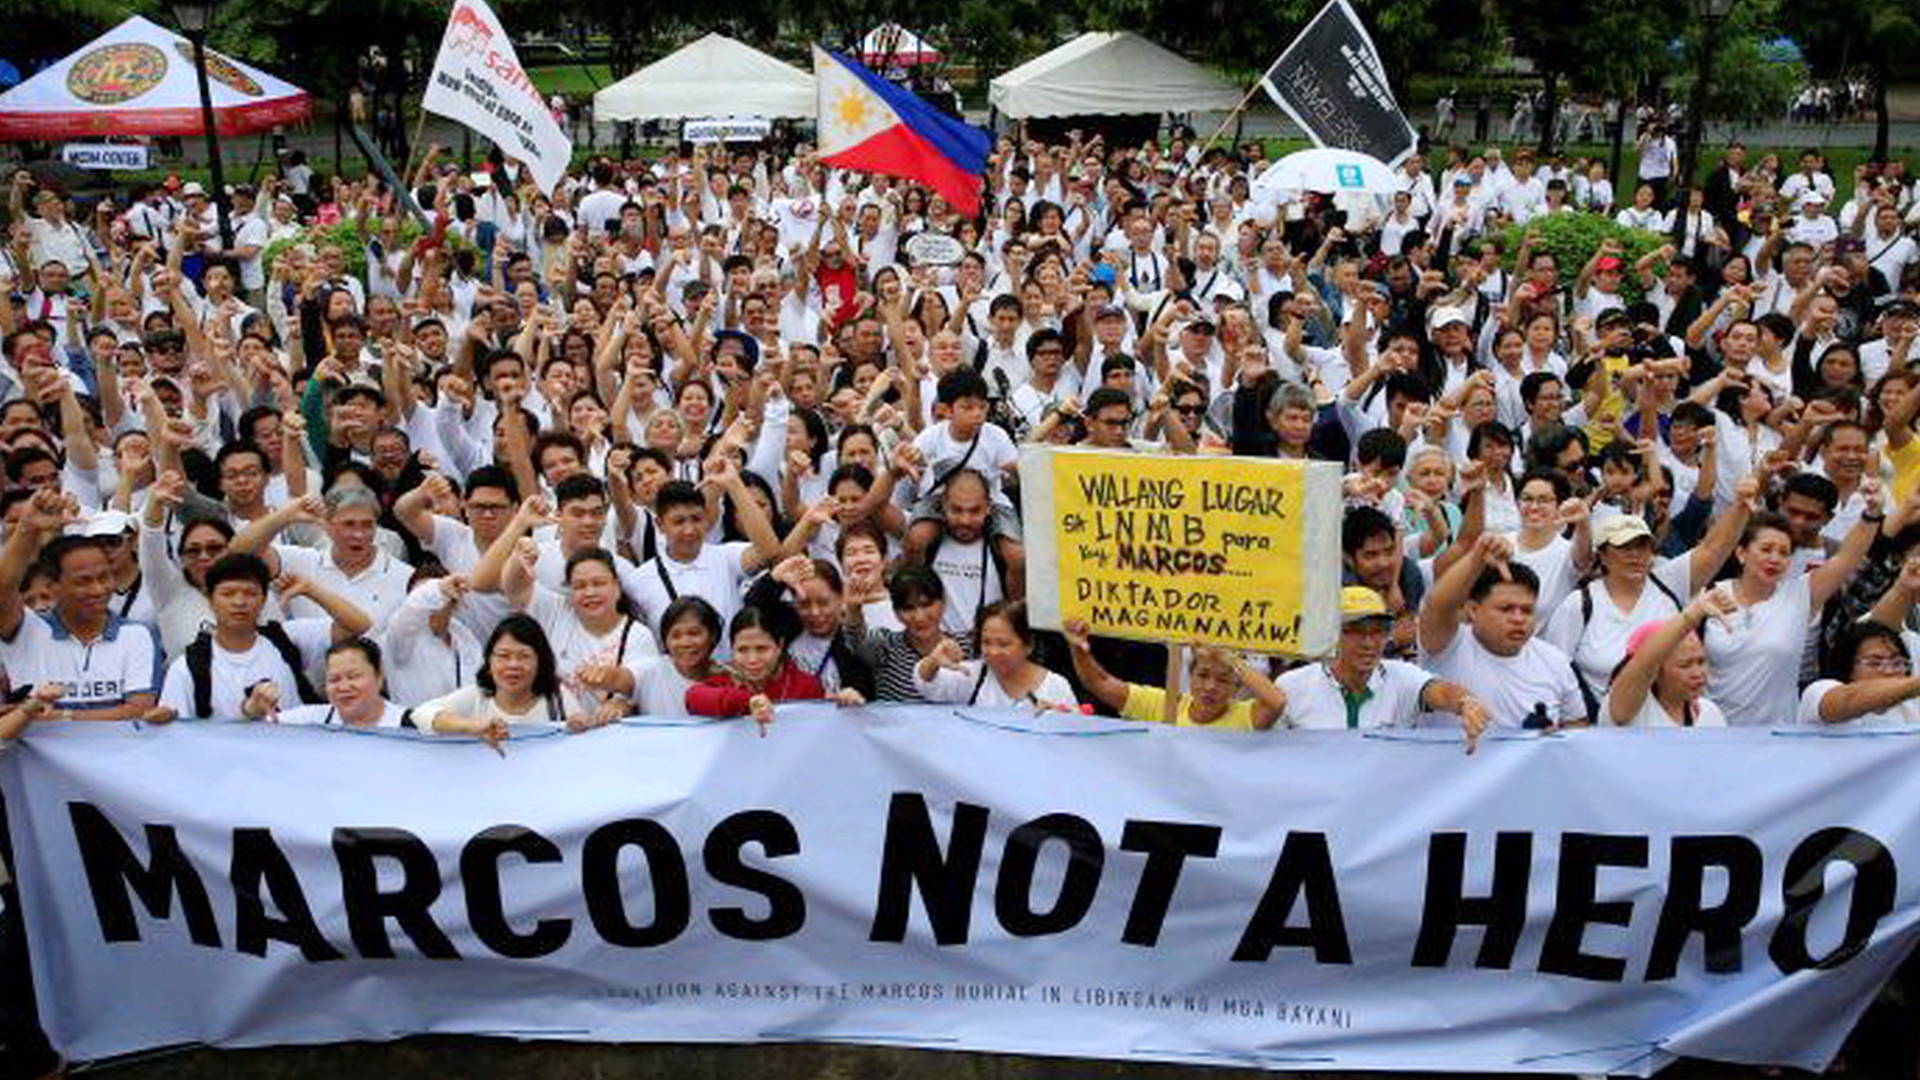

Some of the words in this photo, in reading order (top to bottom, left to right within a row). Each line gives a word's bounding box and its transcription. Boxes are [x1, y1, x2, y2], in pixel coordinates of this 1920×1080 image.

[1078, 473, 1185, 510] WALANG
[1201, 480, 1286, 519] LUGAR
[1221, 532, 1270, 554] para
[1077, 577, 1222, 613] DIKTADOR
[1239, 600, 1273, 619] AT
[1091, 606, 1302, 644] MAGNANAKAW!
[68, 801, 806, 962] MARCOS
[870, 792, 1222, 948] NOT
[1230, 830, 1353, 964] A
[1411, 826, 1898, 982] HERO
[714, 982, 800, 1000] AGAINST
[860, 983, 945, 1000] MARCOS
[954, 983, 1025, 1001] BURIAL
[1042, 985, 1061, 1004] IN
[1277, 1002, 1351, 1029] BAYANI
